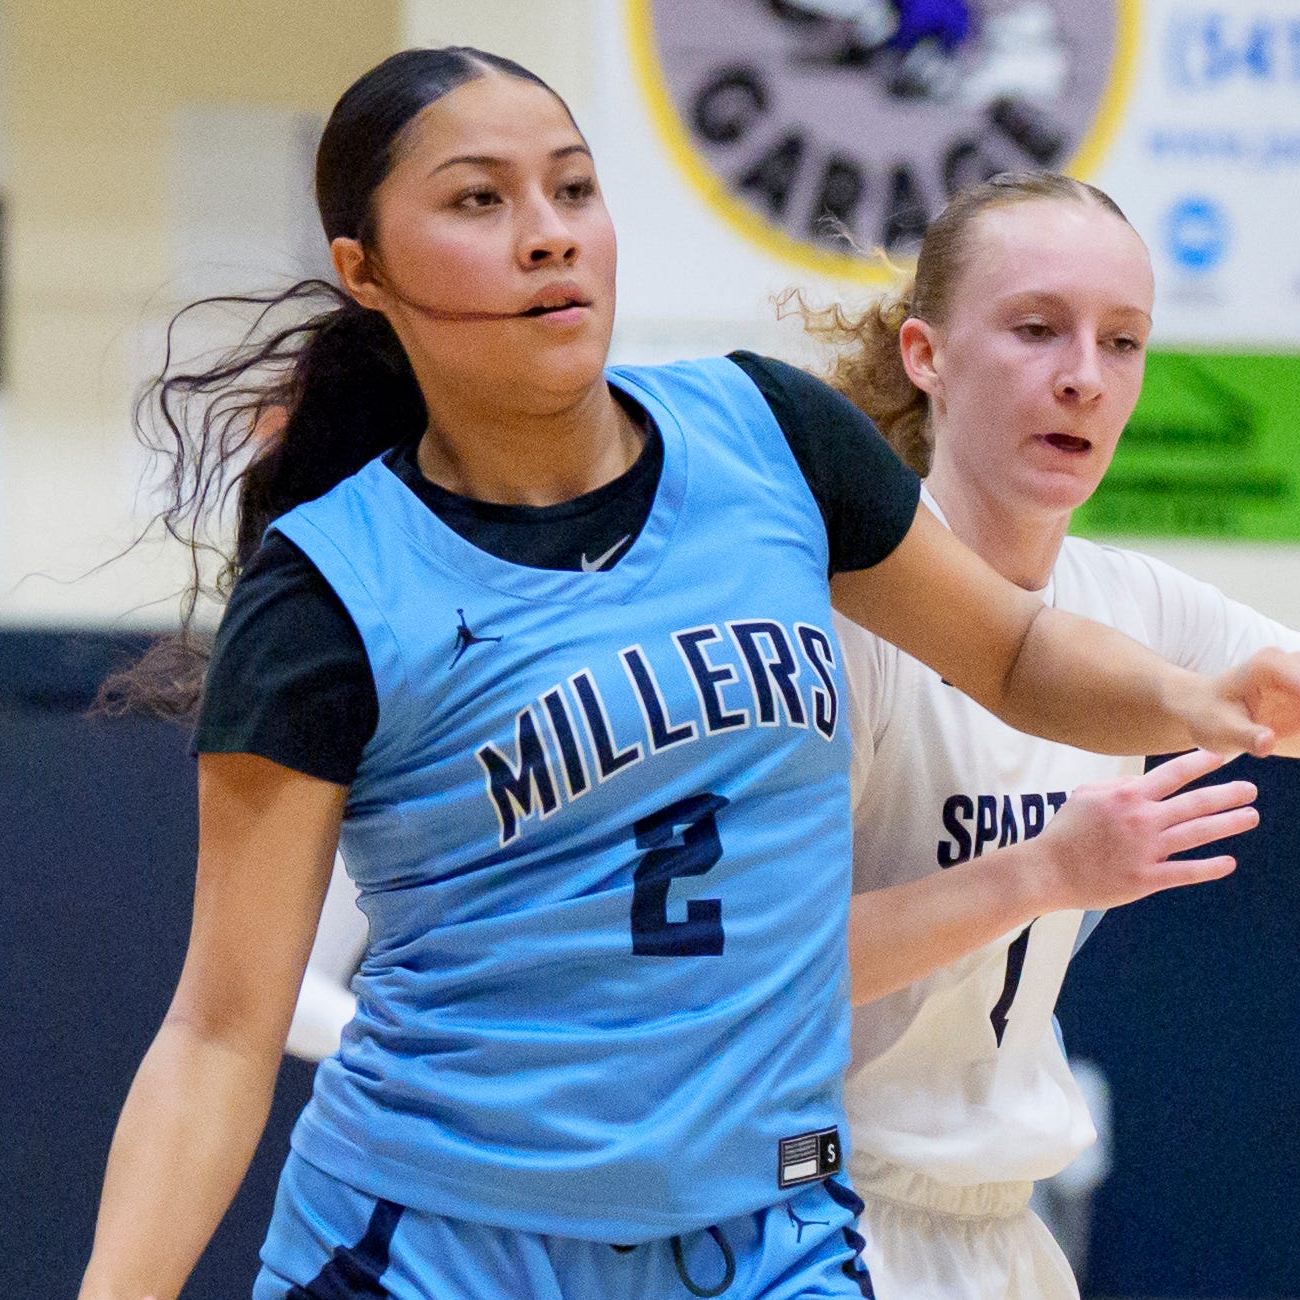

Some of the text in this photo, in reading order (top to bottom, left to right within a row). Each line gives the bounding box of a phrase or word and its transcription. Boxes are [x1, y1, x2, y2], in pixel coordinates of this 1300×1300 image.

[473, 617, 840, 850] MILLERS
[630, 792, 730, 958] 2
[826, 1142, 837, 1164] S
